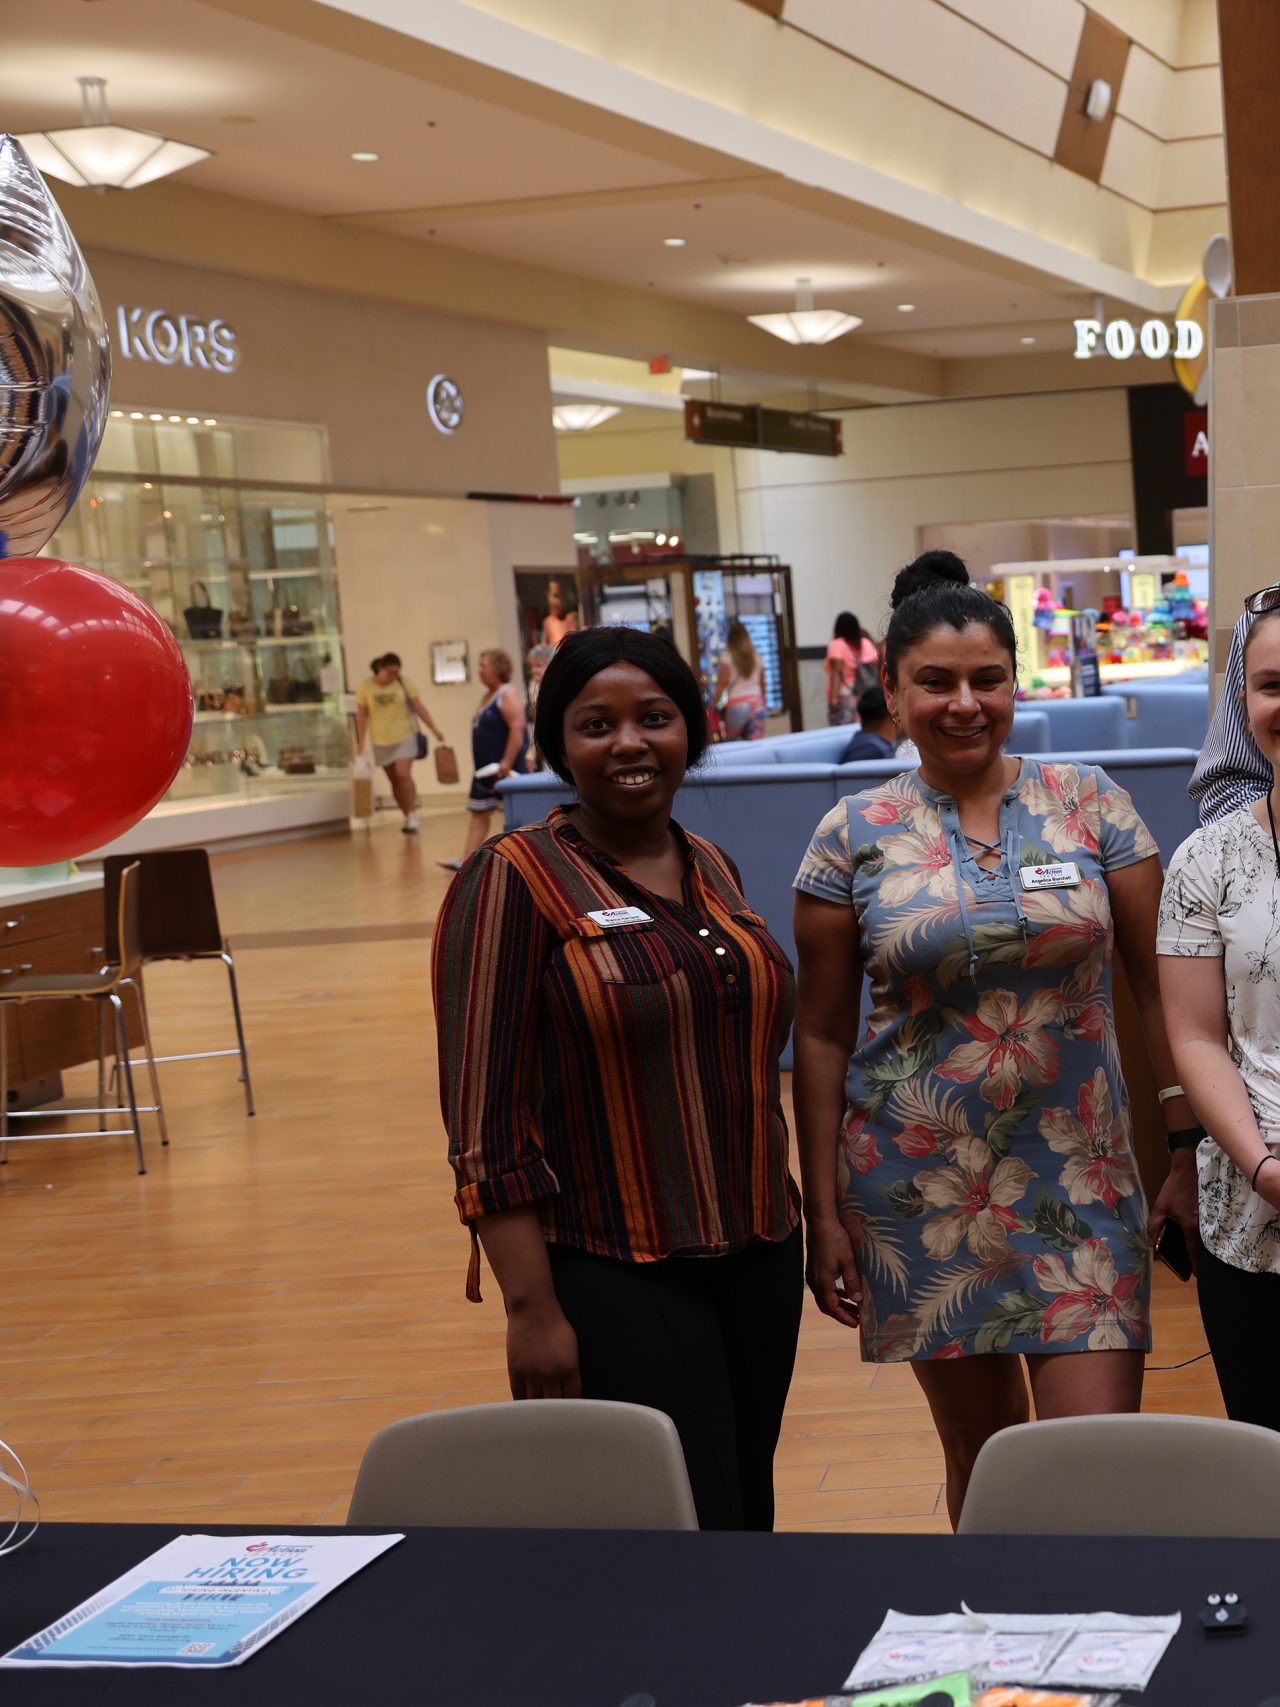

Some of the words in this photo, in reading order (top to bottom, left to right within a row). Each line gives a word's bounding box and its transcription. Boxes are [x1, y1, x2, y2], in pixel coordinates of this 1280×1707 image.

[116, 305, 240, 374] KORS
[1073, 319, 1204, 360] FOOD
[184, 1567, 309, 1579] HIRING
[219, 1557, 304, 1568] NOW
